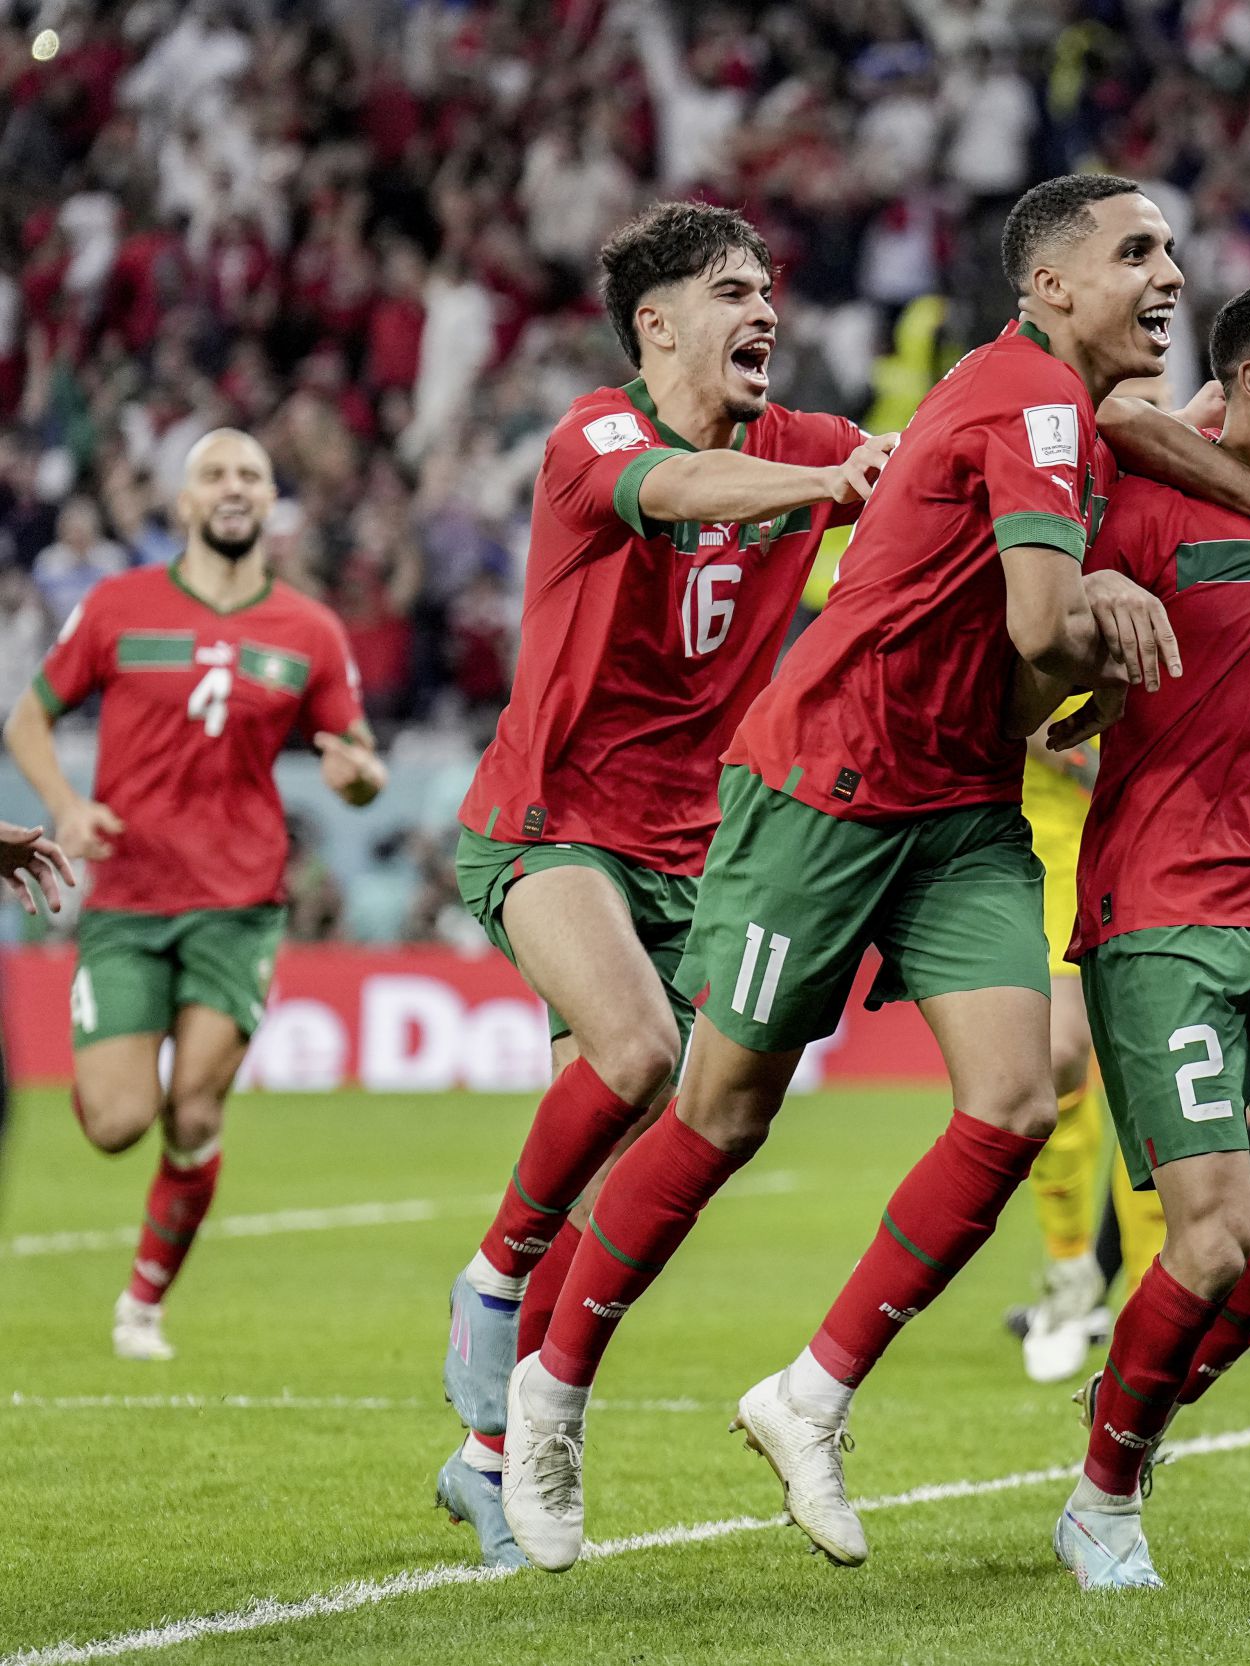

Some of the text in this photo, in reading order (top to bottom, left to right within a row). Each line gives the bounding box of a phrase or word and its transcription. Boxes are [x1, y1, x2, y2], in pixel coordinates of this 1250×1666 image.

[699, 531, 724, 546] UMA
[681, 564, 742, 658] 16
[187, 667, 233, 737] 4
[70, 966, 98, 1033] 4
[731, 922, 791, 1025] 11
[1168, 1024, 1234, 1123] 2
[1103, 1421, 1146, 1449] PUMA
